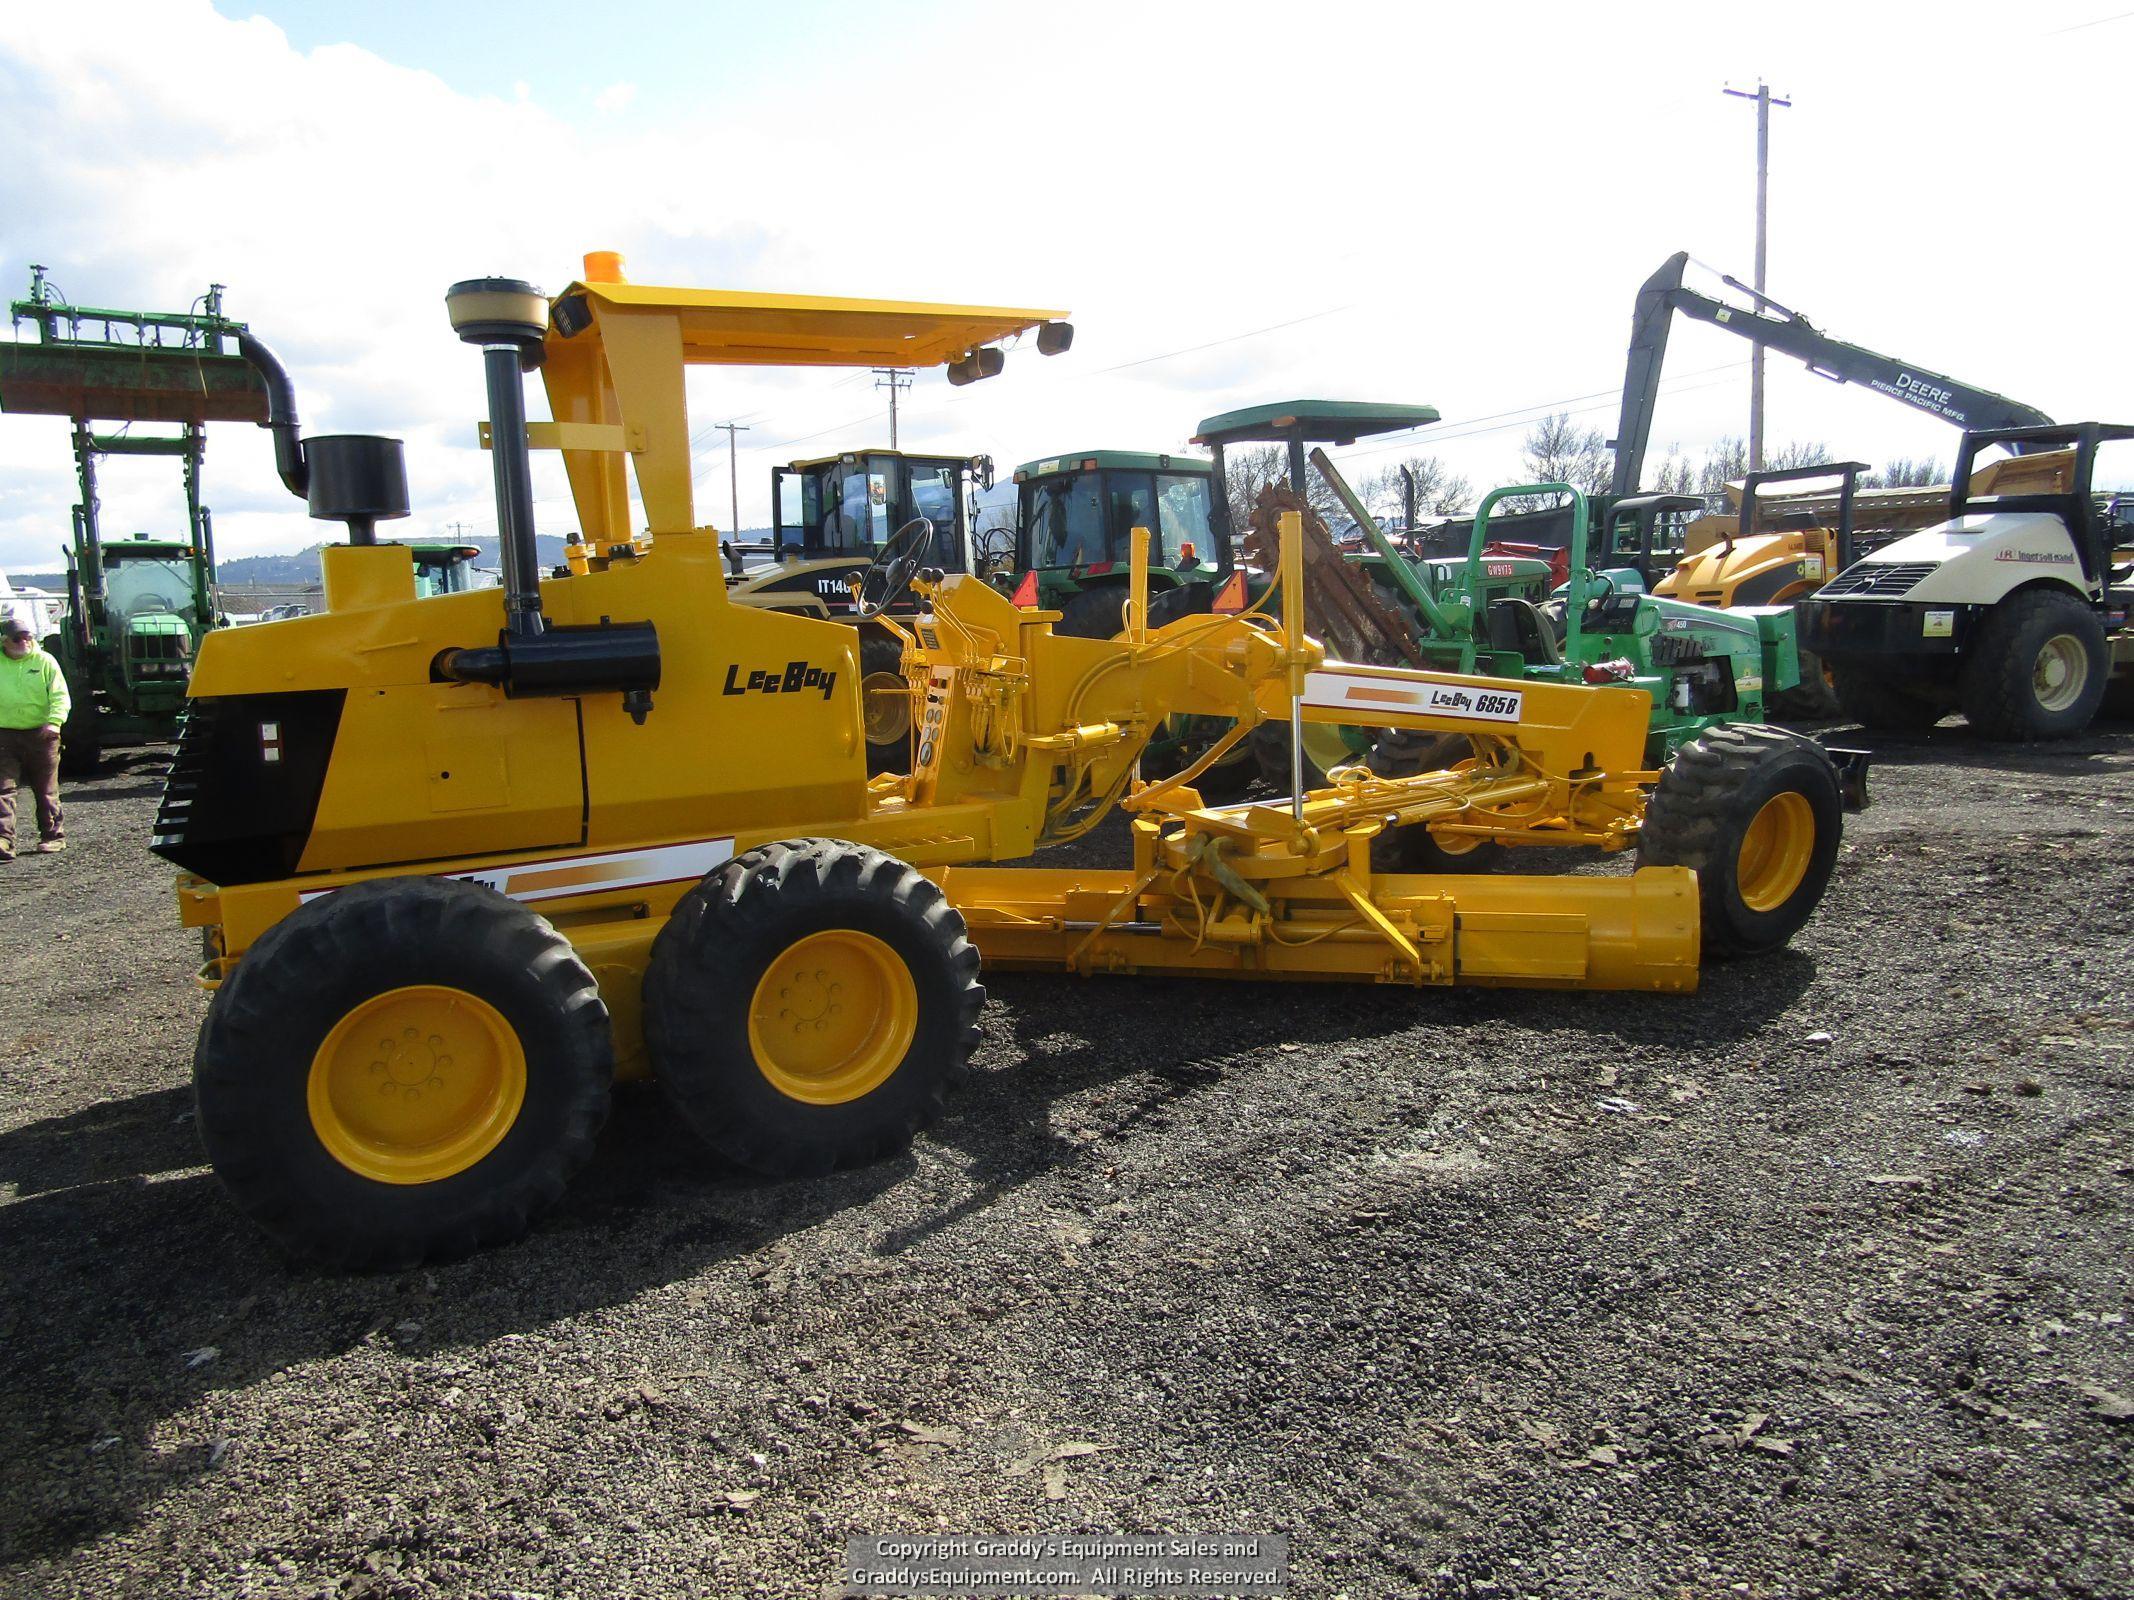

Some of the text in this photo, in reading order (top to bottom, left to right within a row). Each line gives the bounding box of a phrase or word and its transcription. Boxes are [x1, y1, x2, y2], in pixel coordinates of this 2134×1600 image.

[1871, 380, 1966, 422] PIERCE PACIFIC MFG.
[1896, 373, 1952, 405] DEERE
[818, 579, 852, 594] IT14G
[722, 661, 837, 701] LeeBoy
[1430, 690, 1519, 715] LeeBoy 685B
